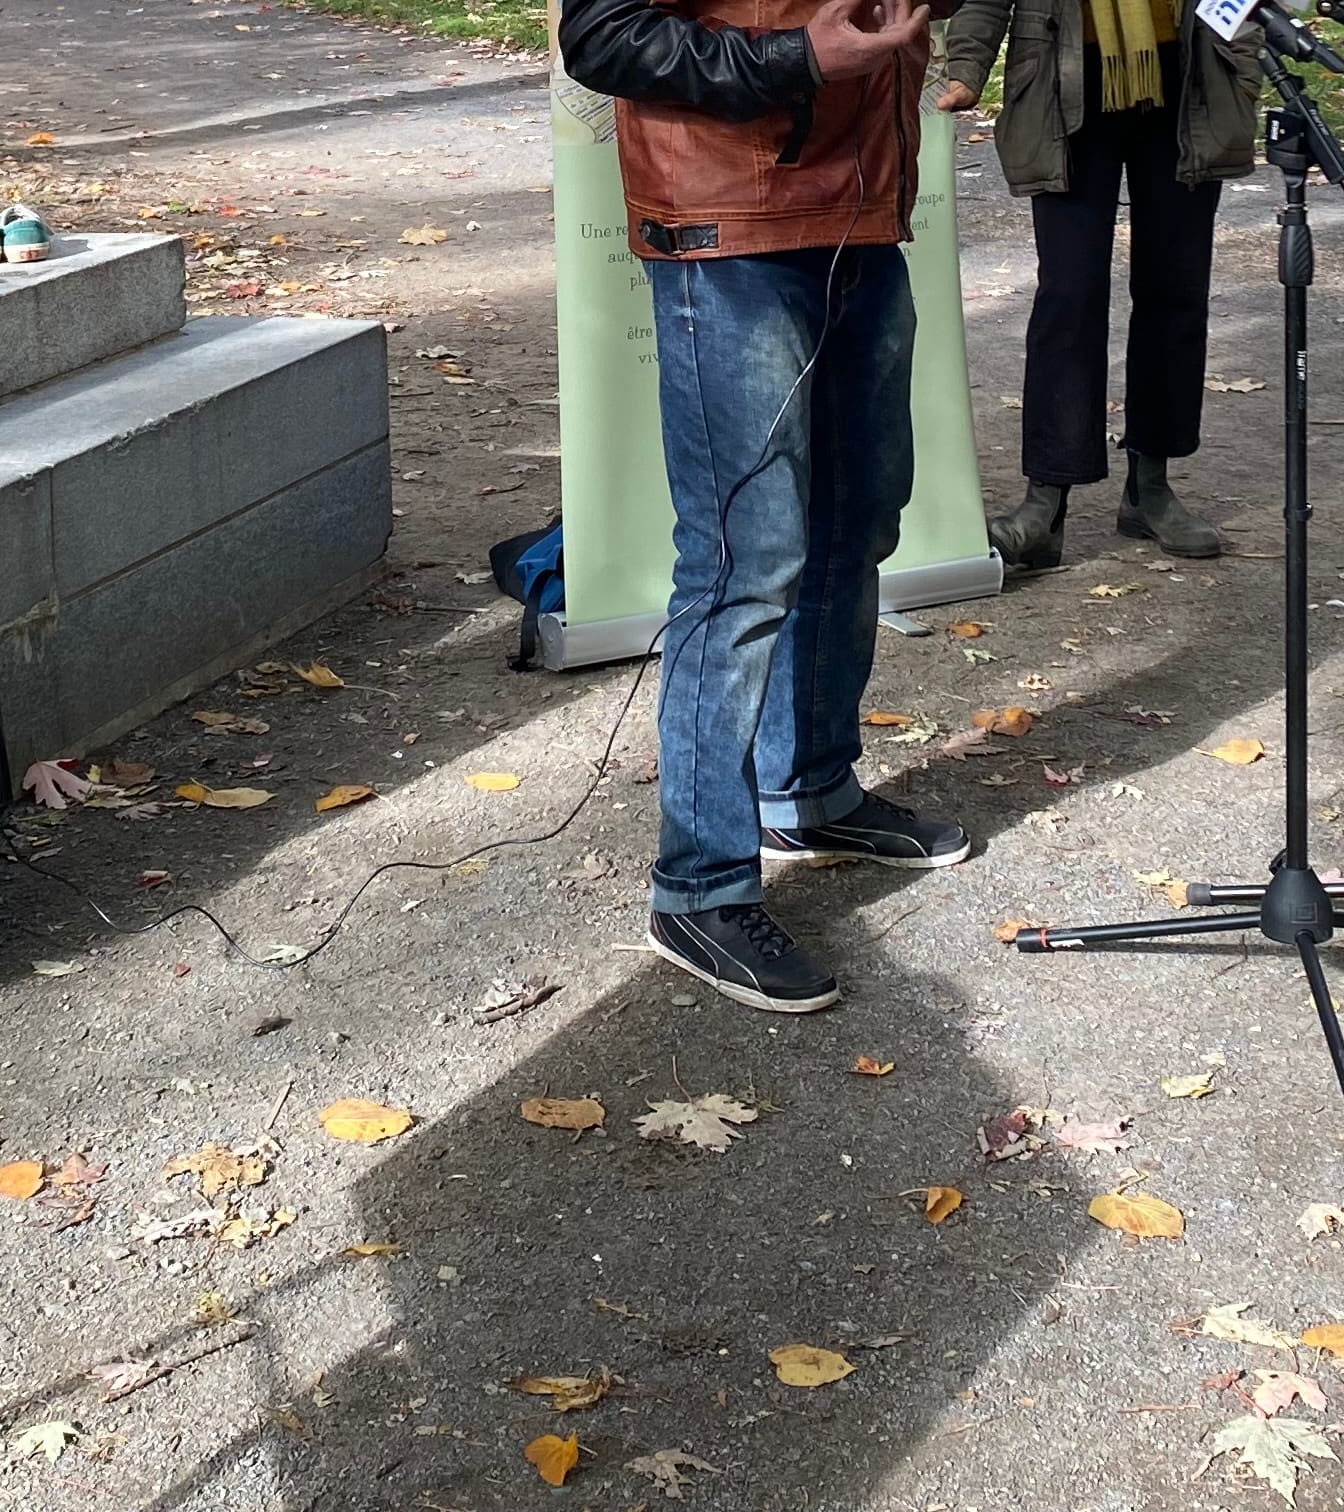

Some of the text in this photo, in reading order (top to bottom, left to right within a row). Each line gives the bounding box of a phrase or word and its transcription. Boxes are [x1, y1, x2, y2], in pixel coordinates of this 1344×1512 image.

[916, 193, 945, 207] oupe
[581, 223, 612, 239] Une
[627, 327, 653, 341] être
